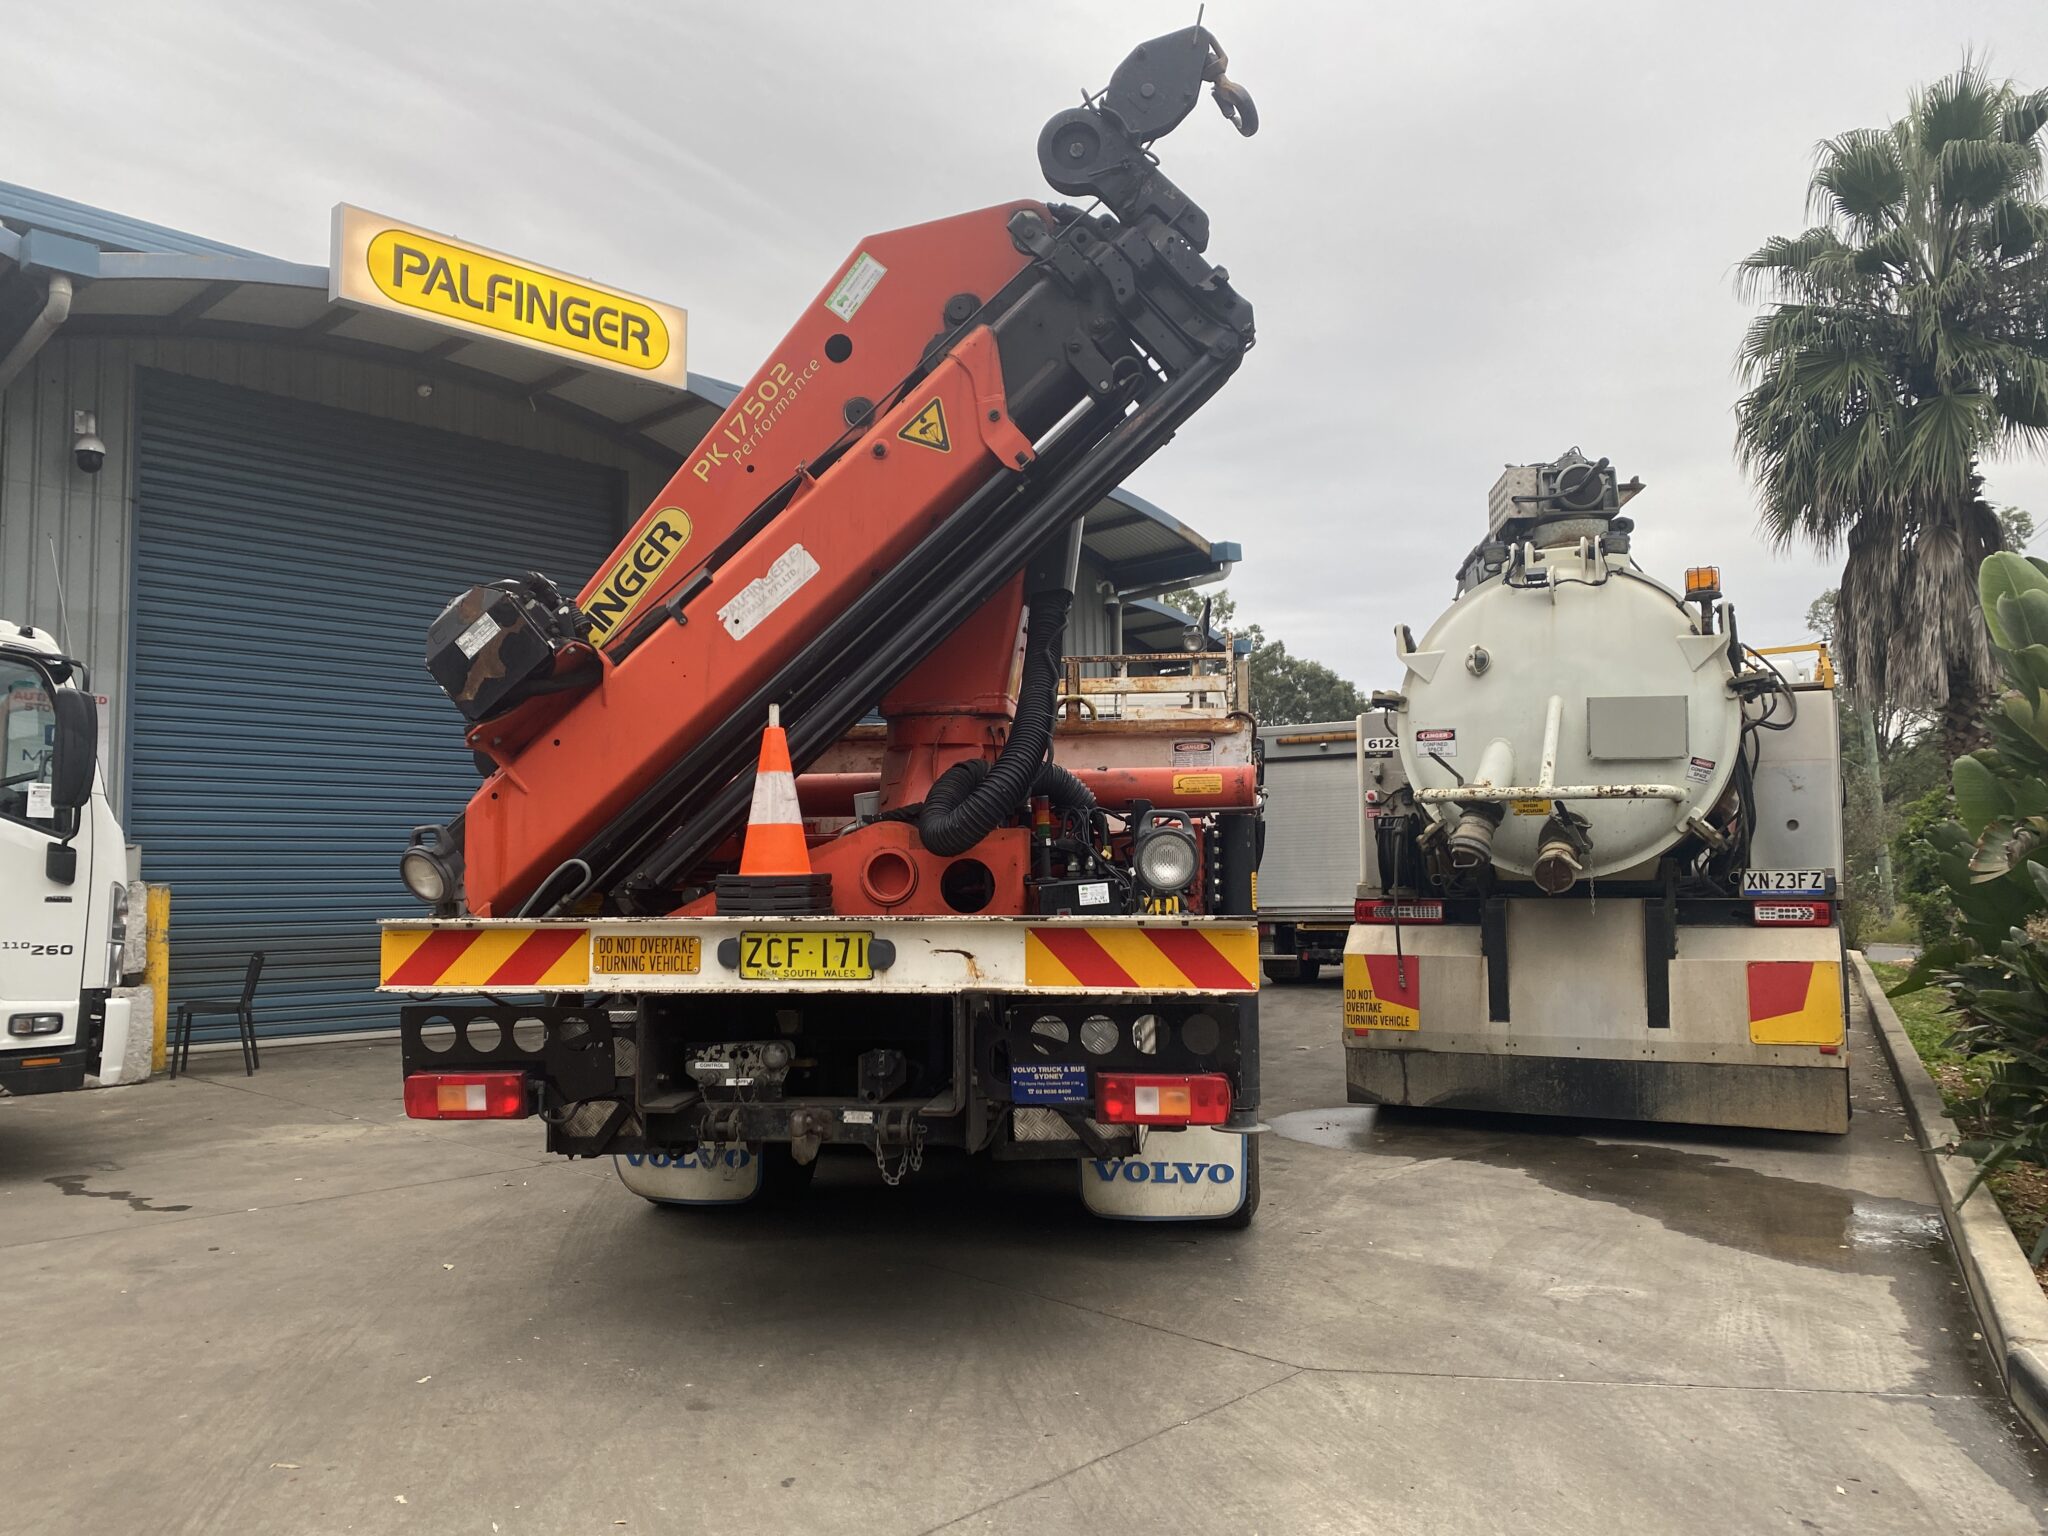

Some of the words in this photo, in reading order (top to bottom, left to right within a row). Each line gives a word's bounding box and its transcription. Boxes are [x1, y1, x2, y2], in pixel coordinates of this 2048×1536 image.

[393, 243, 650, 356] PALFINGER
[732, 359, 820, 465] Performance
[692, 442, 729, 483] PK
[724, 362, 794, 444] 17502
[585, 521, 683, 634] INGER
[2, 941, 30, 949] 110
[31, 945, 73, 955] 260
[600, 938, 613, 954] DO
[616, 938, 636, 954] NOT
[640, 938, 695, 954] OVERTAKE
[601, 956, 645, 972] TURNING
[650, 956, 693, 972] VEHICLE
[757, 969, 778, 977] NW
[783, 969, 817, 977] SOUTH
[824, 969, 856, 977] WALES
[1346, 989, 1356, 999] DO
[1359, 990, 1372, 1000] NOT
[1346, 1002, 1382, 1013] OVERTAKE
[1346, 1014, 1378, 1025] TURNING
[1380, 1015, 1410, 1026] VEHICLE
[1090, 1160, 1234, 1184] VOLVO
